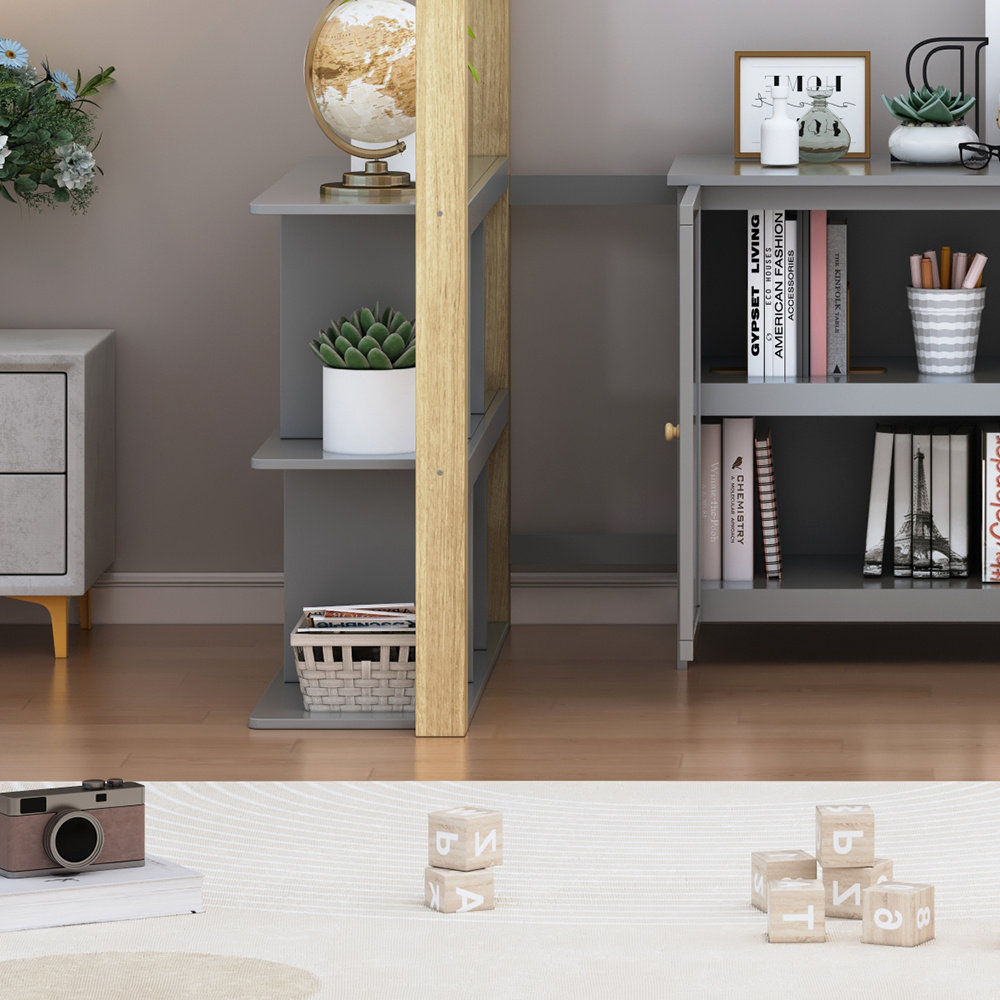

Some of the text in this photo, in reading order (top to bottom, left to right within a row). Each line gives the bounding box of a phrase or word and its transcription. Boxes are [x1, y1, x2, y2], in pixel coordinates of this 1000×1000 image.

[751, 214, 760, 357] GYPSET LIVING
[774, 212, 784, 359] AMERICAN FASHION
[787, 249, 795, 321] ACCESSORIES
[737, 474, 745, 545] CHEMISTRY
